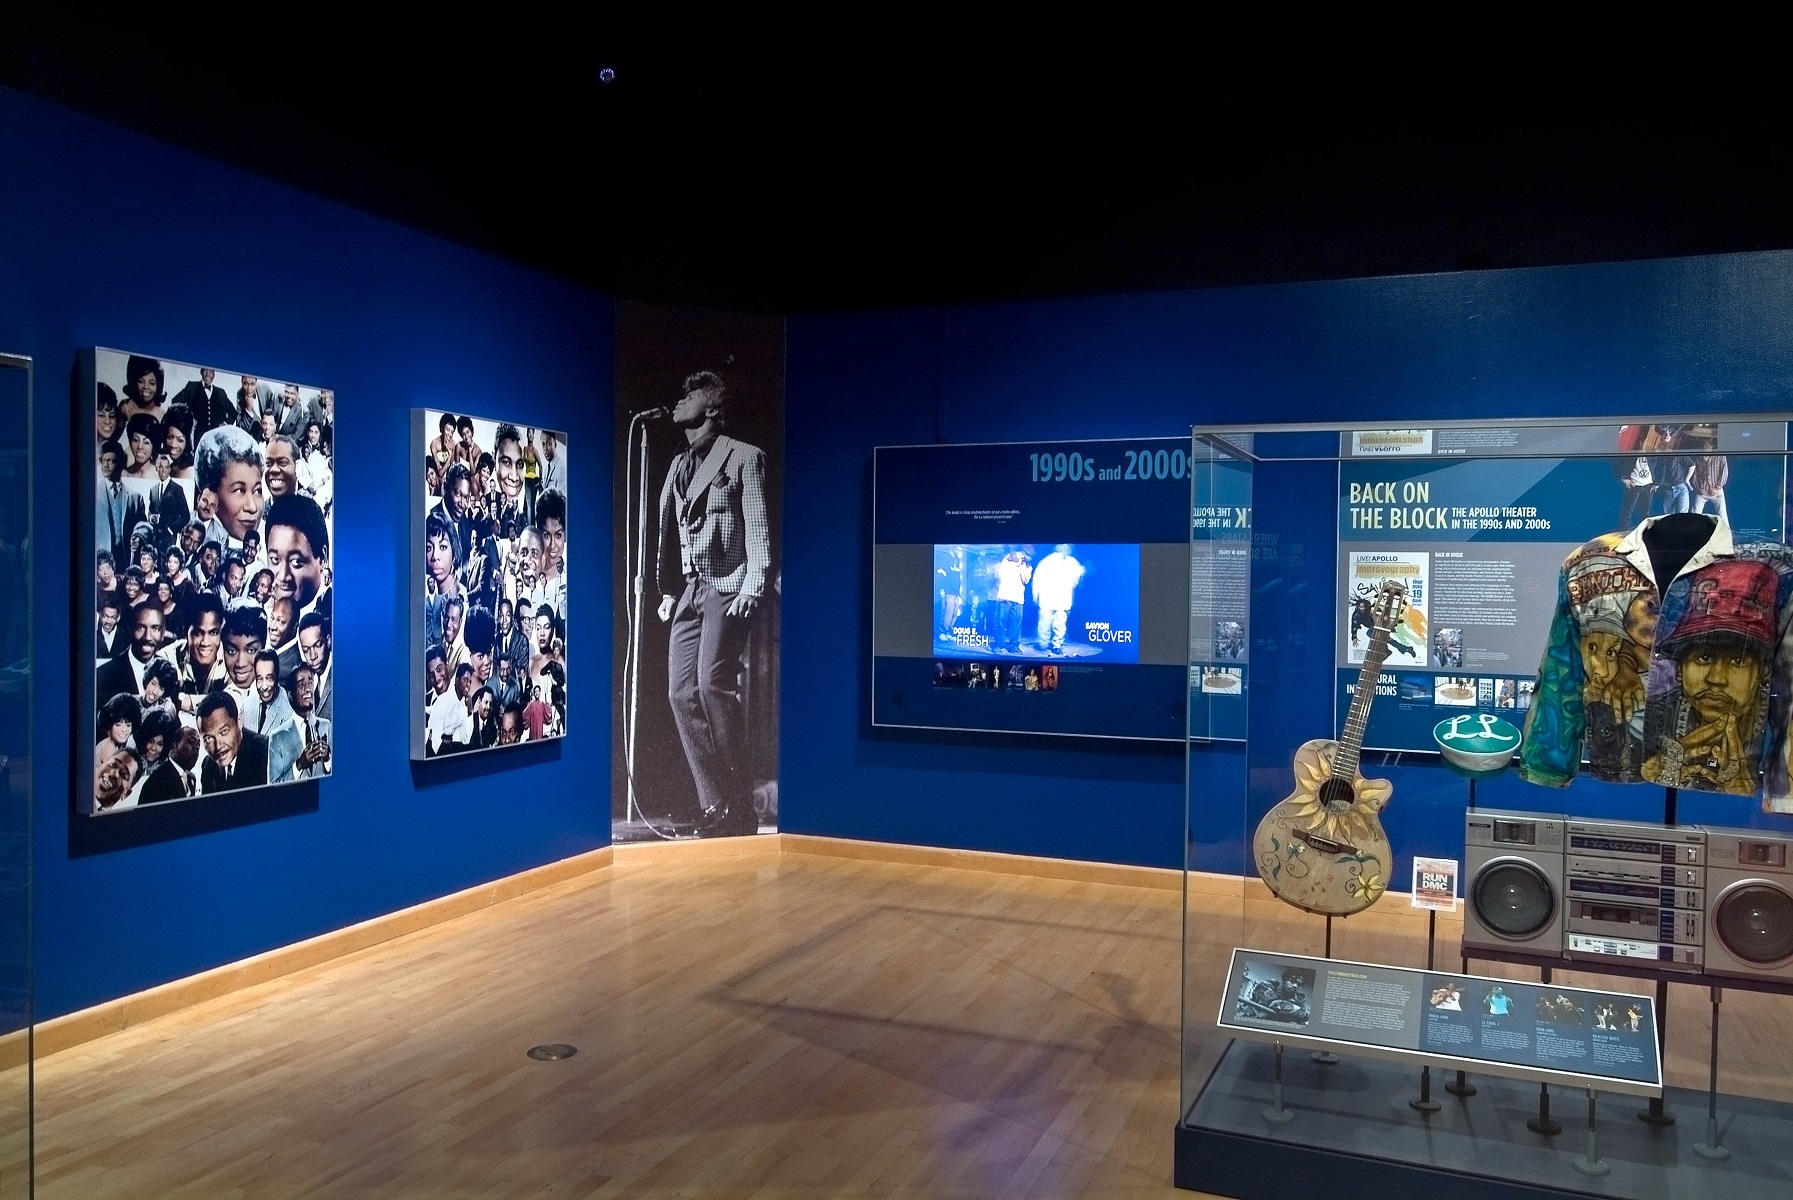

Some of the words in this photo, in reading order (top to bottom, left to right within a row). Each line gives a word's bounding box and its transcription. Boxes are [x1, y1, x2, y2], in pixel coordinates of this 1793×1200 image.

[1029, 452, 1095, 482] 1990s
[1098, 465, 1121, 480] and
[1350, 482, 1397, 504] BACK
[1403, 481, 1429, 504] ON
[1350, 507, 1383, 529] THE
[1390, 507, 1448, 529] BLOCK
[1452, 507, 1467, 518] THE
[1469, 507, 1500, 518] APOLLO
[1501, 506, 1537, 518] THEATER
[1451, 519, 1460, 529] IN
[1462, 519, 1478, 529] THE
[1480, 519, 1503, 530] 1990s
[1505, 519, 1522, 529] AND
[1525, 519, 1551, 530] 2000s
[1412, 589, 1422, 598] 19
[953, 626, 972, 635] DOUG
[1088, 629, 1132, 643] GLOVER
[956, 635, 990, 647] FRESH
[1422, 872, 1448, 883] RUN
[1422, 880, 1448, 890] DMC
